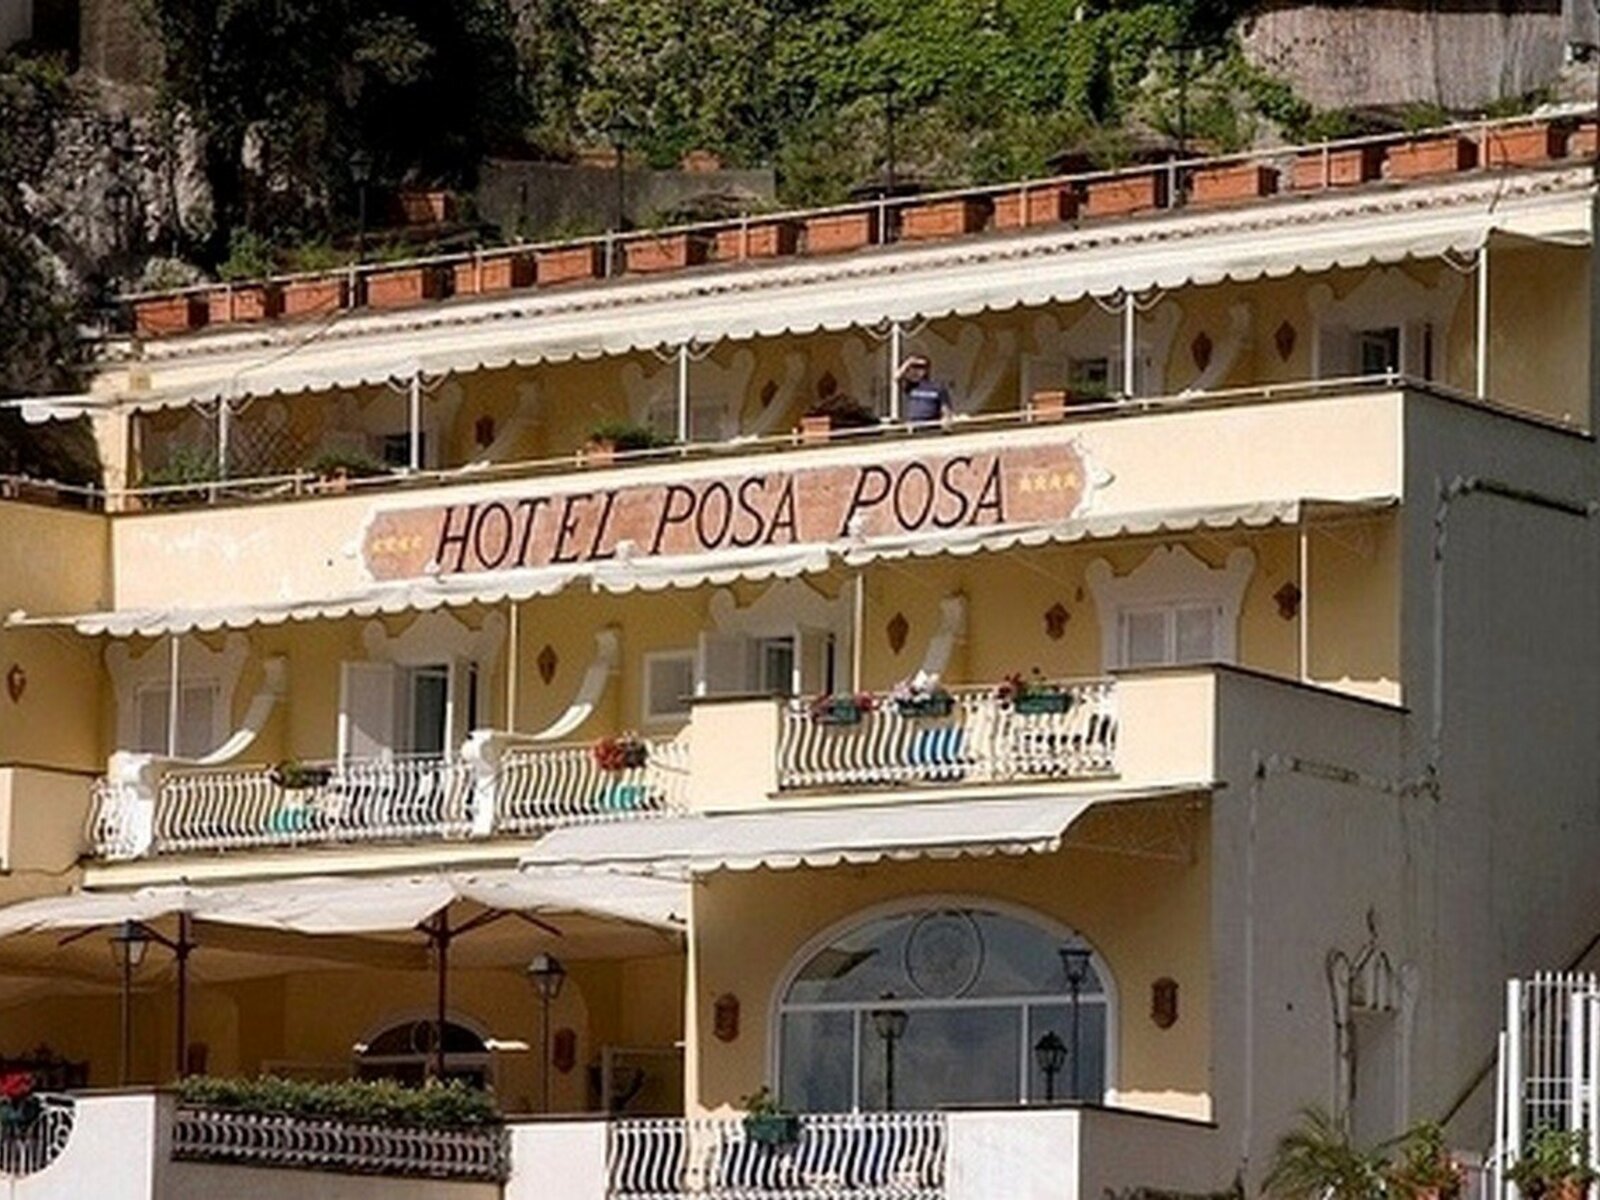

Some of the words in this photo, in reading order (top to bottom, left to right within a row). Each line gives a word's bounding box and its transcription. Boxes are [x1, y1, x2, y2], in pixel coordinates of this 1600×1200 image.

[435, 490, 623, 573] HOTEL
[648, 475, 801, 555] POSA
[839, 456, 1005, 538] POSA
